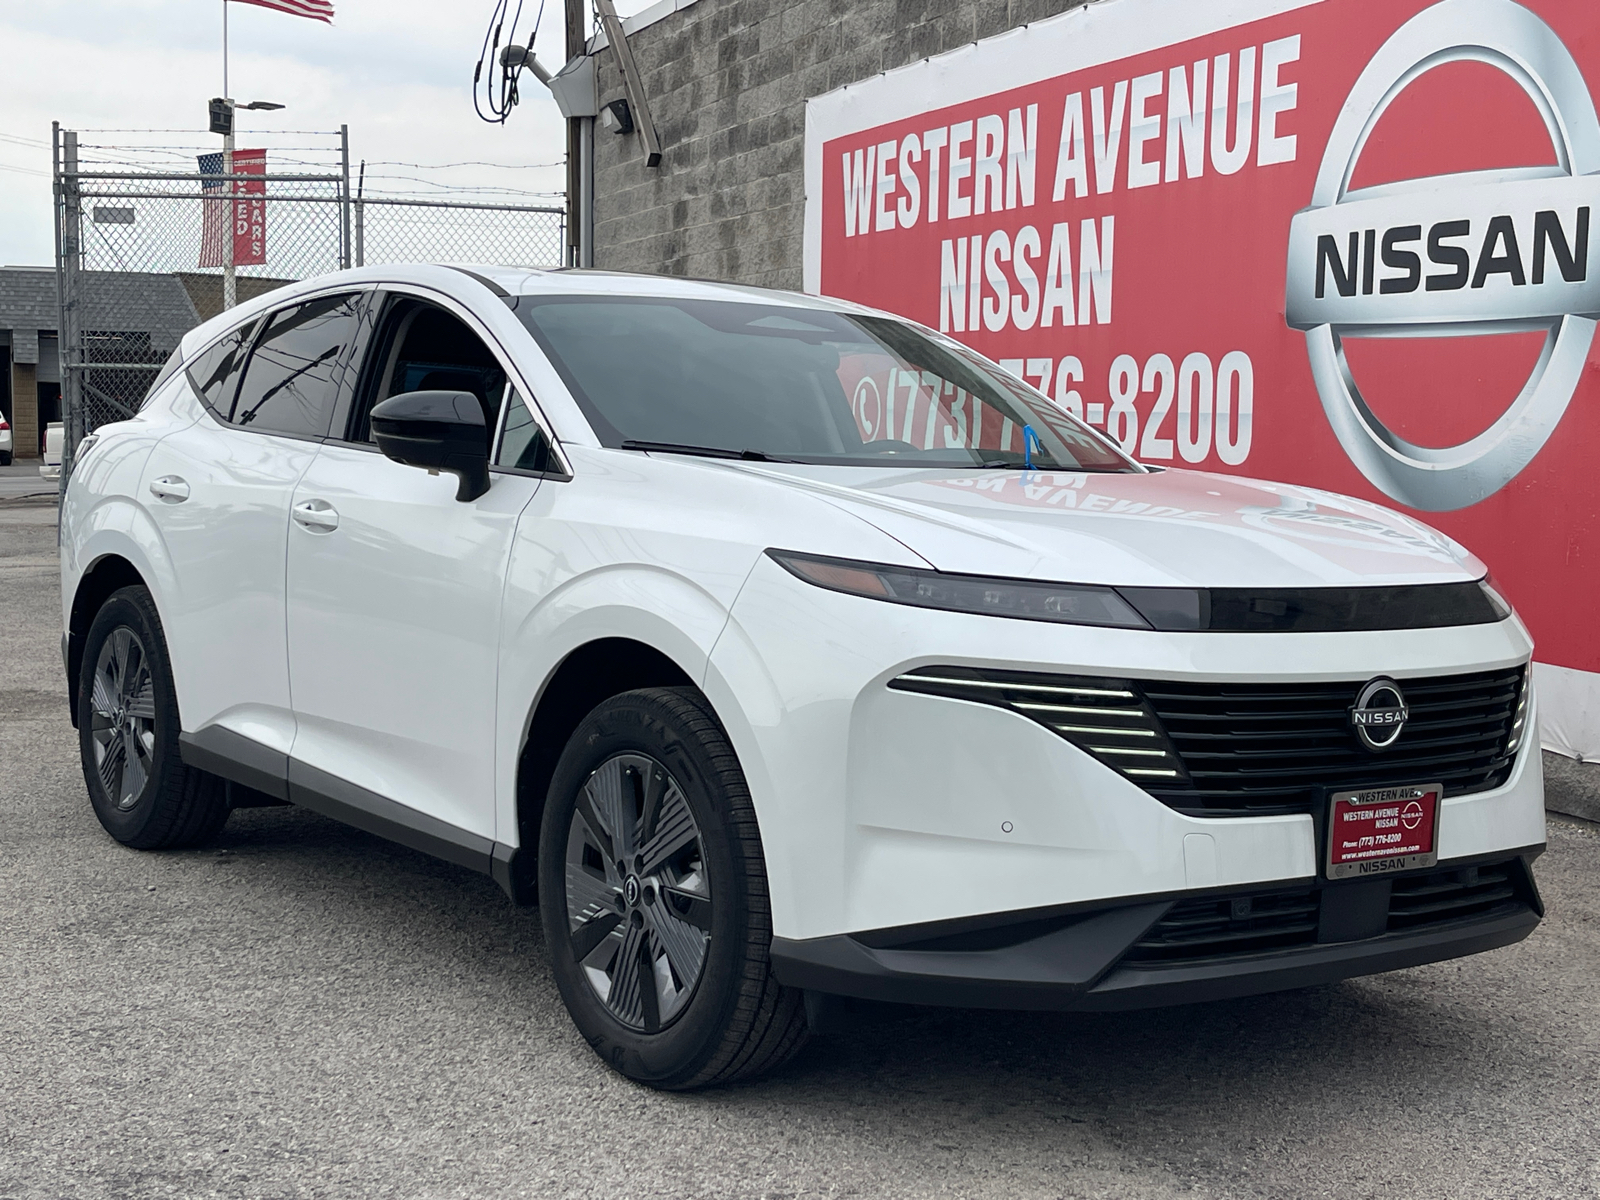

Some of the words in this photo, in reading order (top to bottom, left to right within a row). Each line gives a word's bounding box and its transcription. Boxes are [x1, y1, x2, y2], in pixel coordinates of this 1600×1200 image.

[842, 102, 1039, 237] WESTERN
[1053, 33, 1302, 201] AVENUE
[1315, 205, 1591, 299] NISSAN
[939, 215, 1115, 333] NISSAN
[1354, 710, 1408, 724] NISSAN
[1358, 790, 1397, 803] WESTERN
[1343, 810, 1374, 821] WESTERN
[1374, 807, 1399, 819] AVENUE
[1375, 818, 1399, 829] NISSAN
[1358, 836, 1375, 849] (773)
[1375, 833, 1401, 845] 776-8200
[1359, 858, 1406, 874] NISSAN
